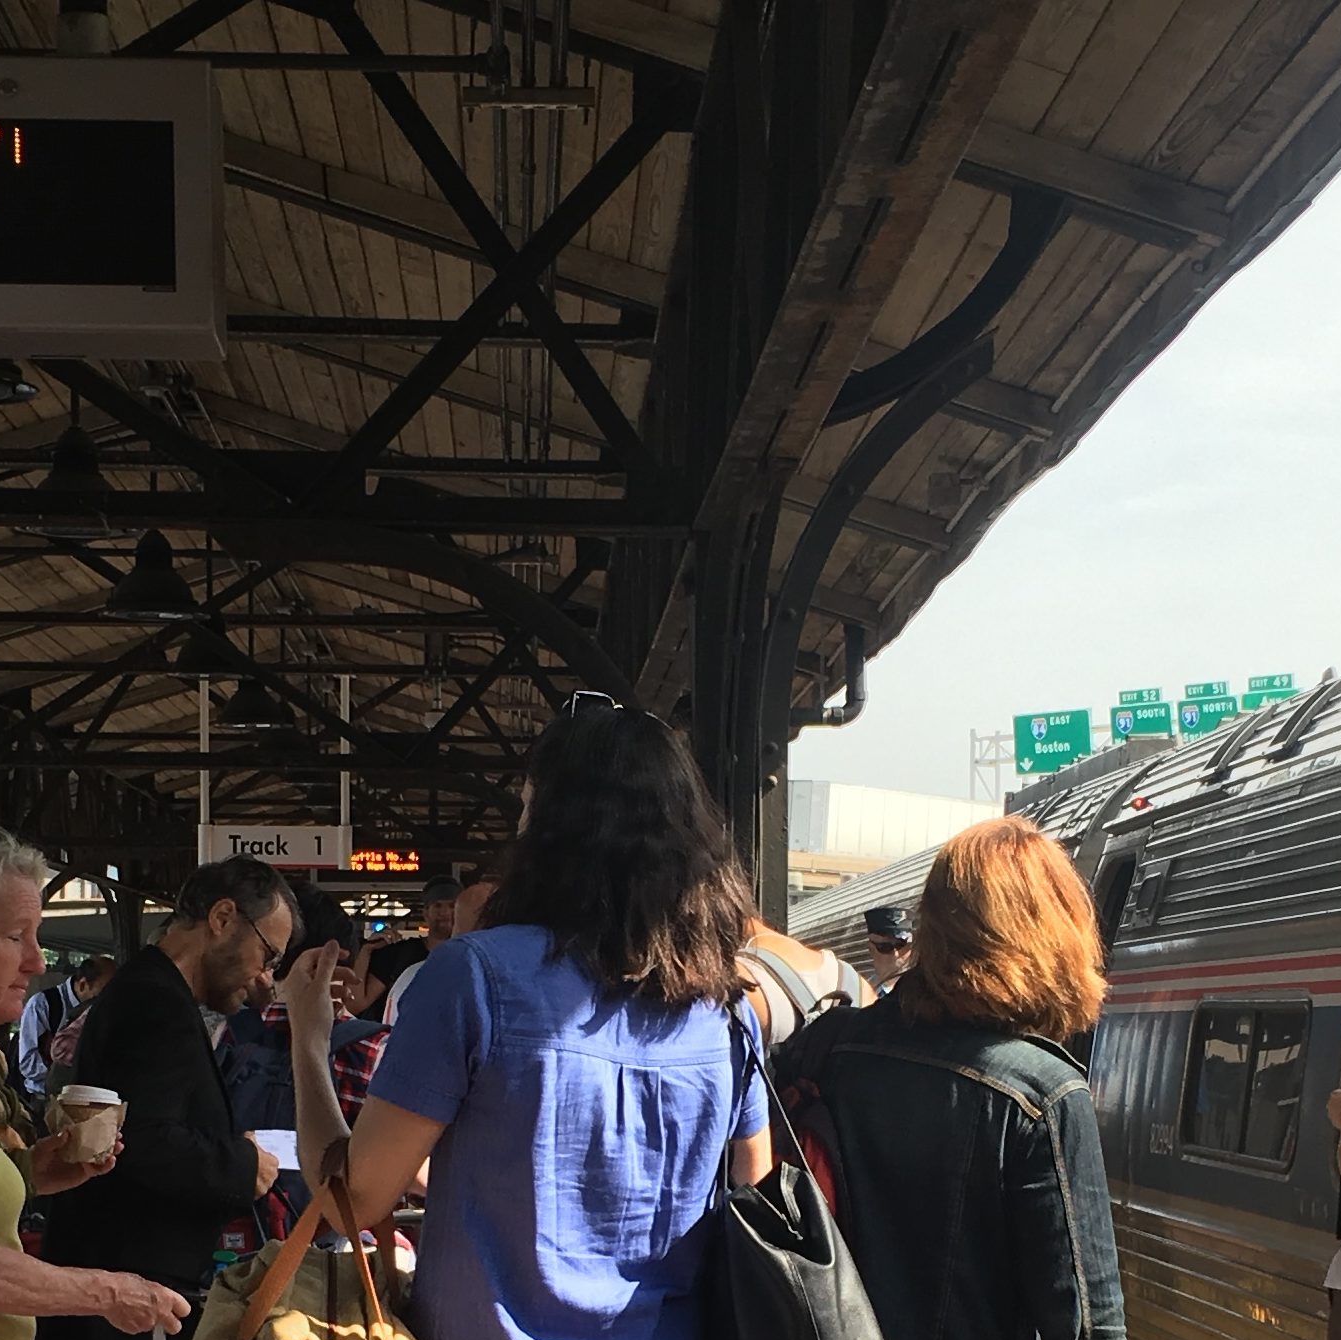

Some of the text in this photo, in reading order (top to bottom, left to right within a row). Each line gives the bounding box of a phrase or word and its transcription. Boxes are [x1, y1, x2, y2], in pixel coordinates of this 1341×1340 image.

[1273, 675, 1289, 687] 49
[1142, 689, 1157, 702] 52
[1118, 707, 1166, 729] 91 SOUTH
[1184, 701, 1233, 723] 91 NORTH
[1049, 714, 1071, 726] EAST
[1034, 740, 1071, 754] Boston
[228, 834, 324, 857] Track 1
